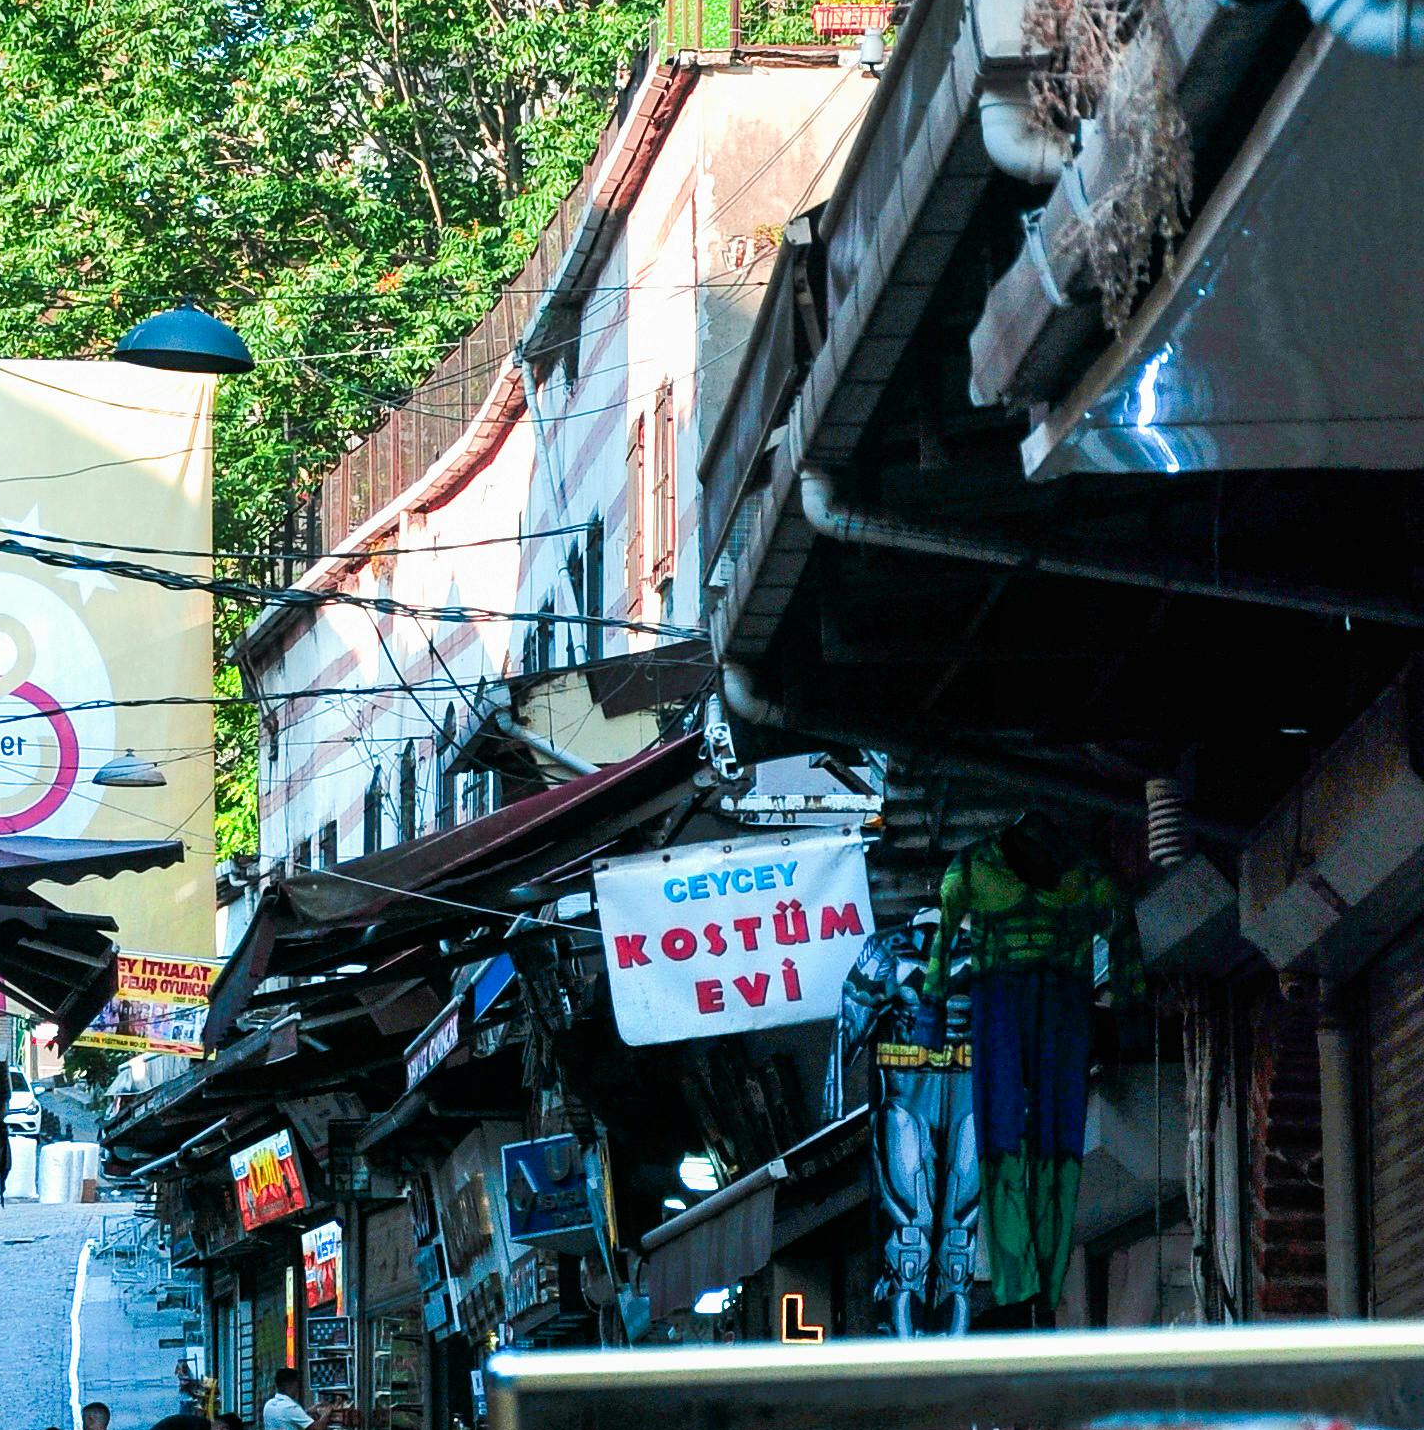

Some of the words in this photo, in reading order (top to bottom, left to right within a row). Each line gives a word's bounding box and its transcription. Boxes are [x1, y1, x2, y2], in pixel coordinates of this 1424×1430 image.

[663, 860, 799, 903] CEYCEY
[613, 898, 865, 969] KOSTÜM
[121, 975, 158, 995] PELUŞ
[141, 958, 211, 981] İTHALAT
[695, 957, 803, 1014] EVİ
